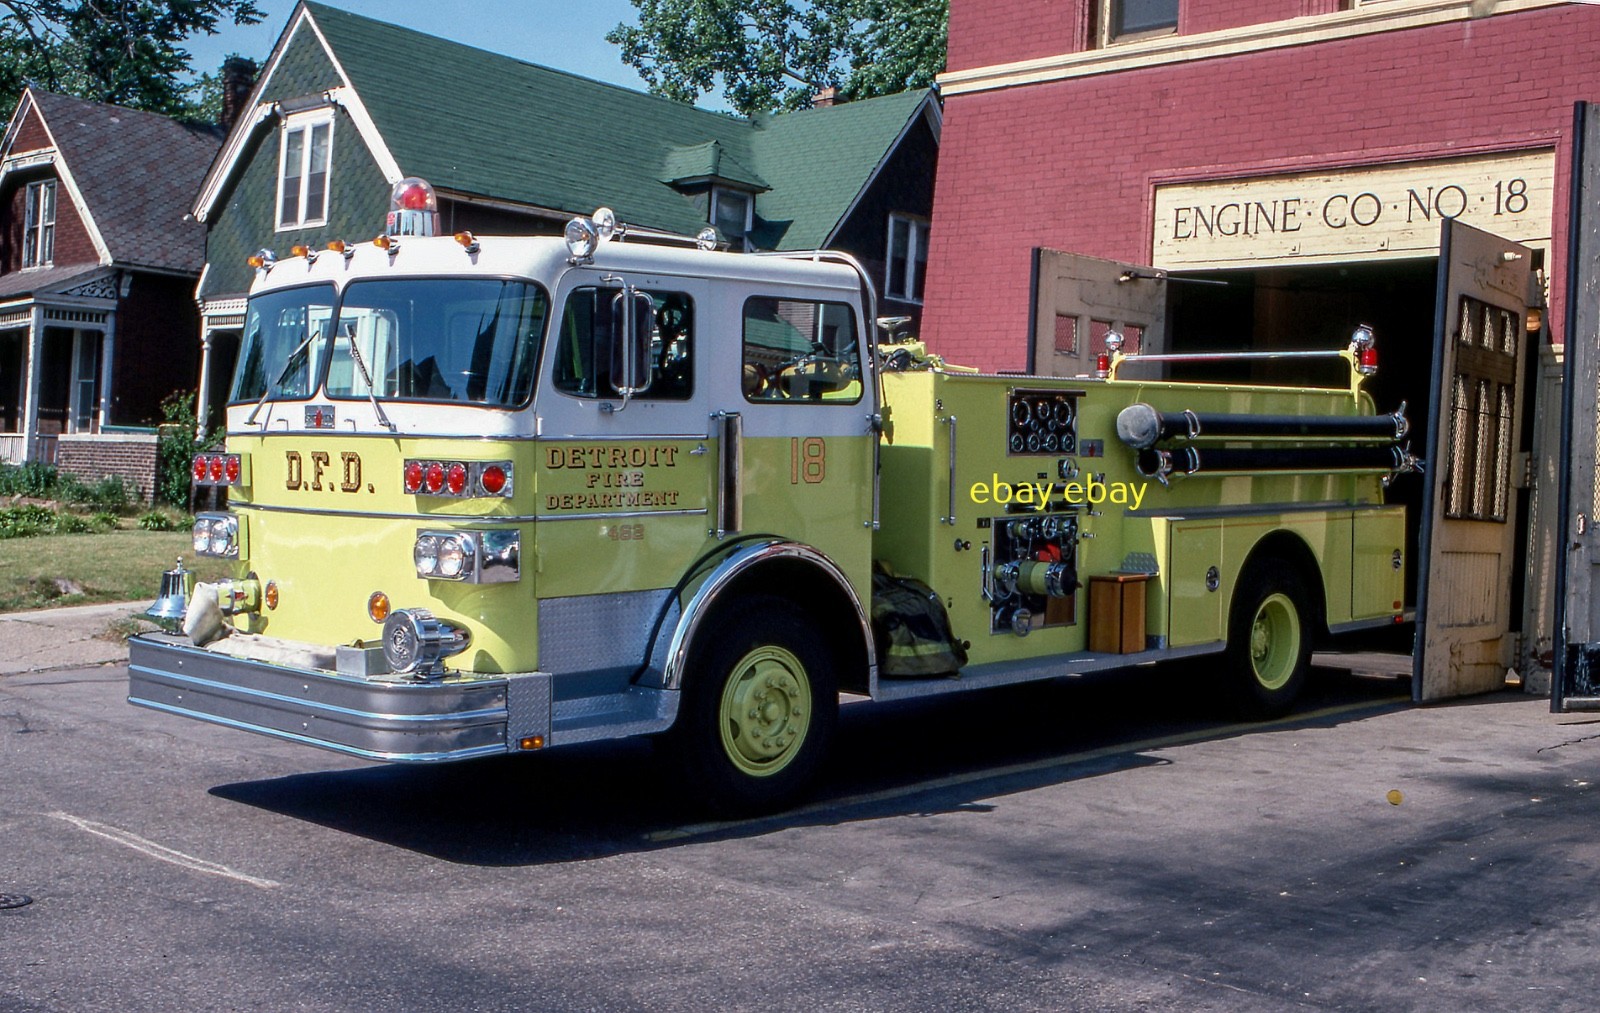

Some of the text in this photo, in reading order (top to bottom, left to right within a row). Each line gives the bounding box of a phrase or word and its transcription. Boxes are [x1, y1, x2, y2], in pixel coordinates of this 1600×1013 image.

[1494, 178, 1529, 216] 18
[285, 450, 376, 494] D.F.D.
[546, 446, 678, 469] DETROIT
[791, 437, 826, 485] 18
[586, 471, 644, 489] FIRE
[546, 491, 679, 511] DEPARTMENT
